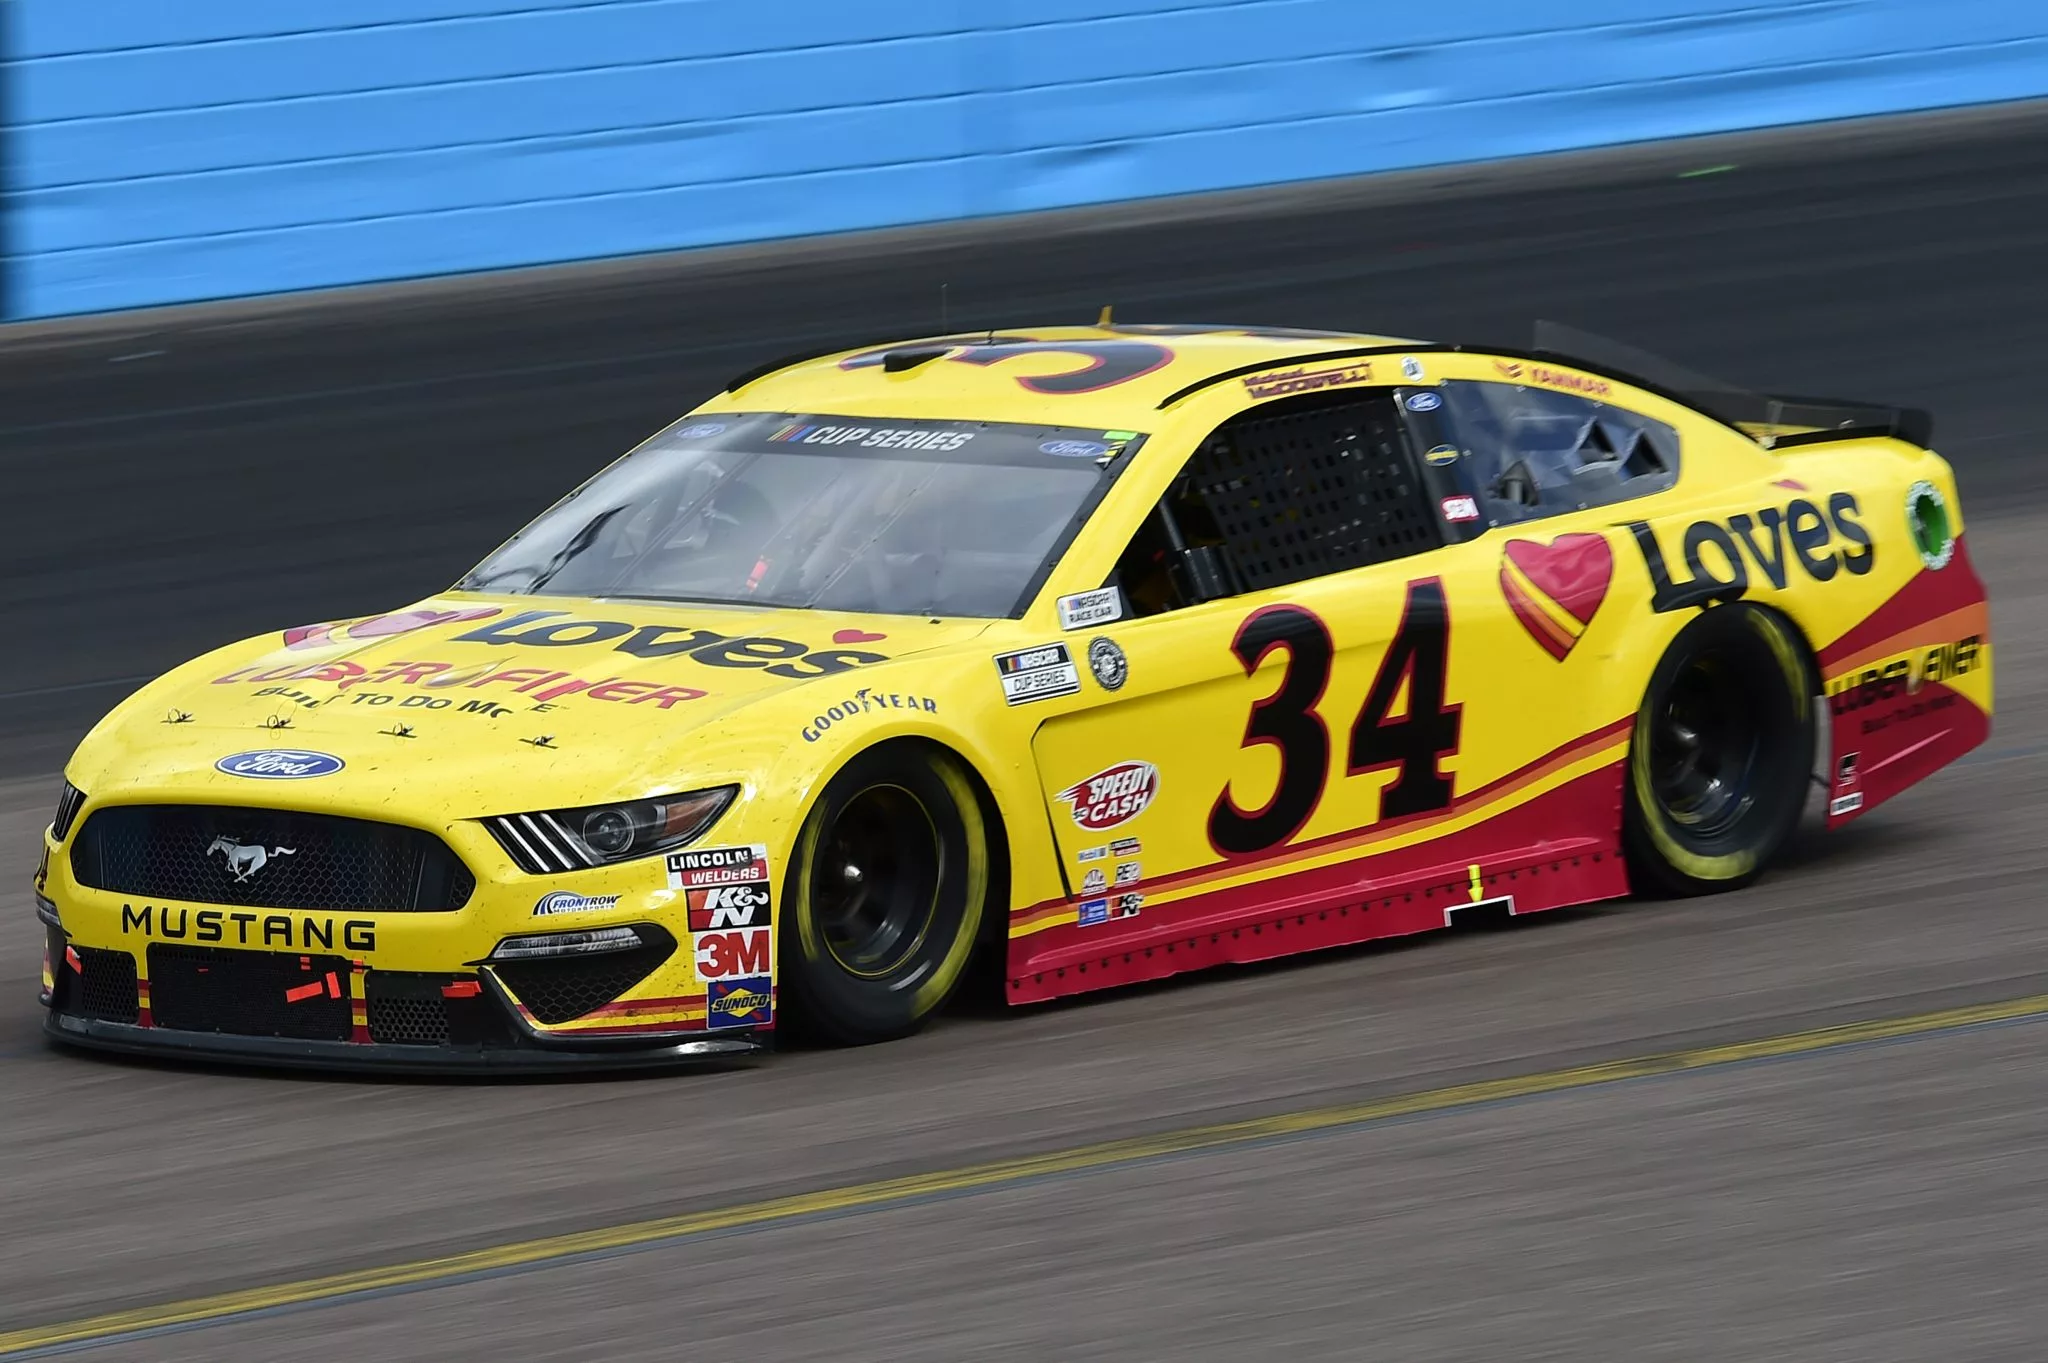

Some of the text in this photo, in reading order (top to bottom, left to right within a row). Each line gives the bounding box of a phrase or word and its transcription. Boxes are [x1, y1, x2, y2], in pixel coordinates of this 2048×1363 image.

[803, 426, 975, 451] CUP SERIES
[1069, 606, 1112, 622] RACE CAR
[1014, 669, 1066, 692] CUP SERIES
[351, 693, 395, 706] TO
[398, 695, 453, 710] DO
[1206, 575, 1465, 858] 34
[234, 751, 323, 775] Ford
[1087, 764, 1154, 804] SPEEDY
[670, 850, 749, 870] LINCOLN
[691, 867, 759, 885] WELDERS
[121, 903, 377, 952] MUSTANG
[697, 930, 770, 978] 3M
[712, 994, 769, 1012] SUNOCO
